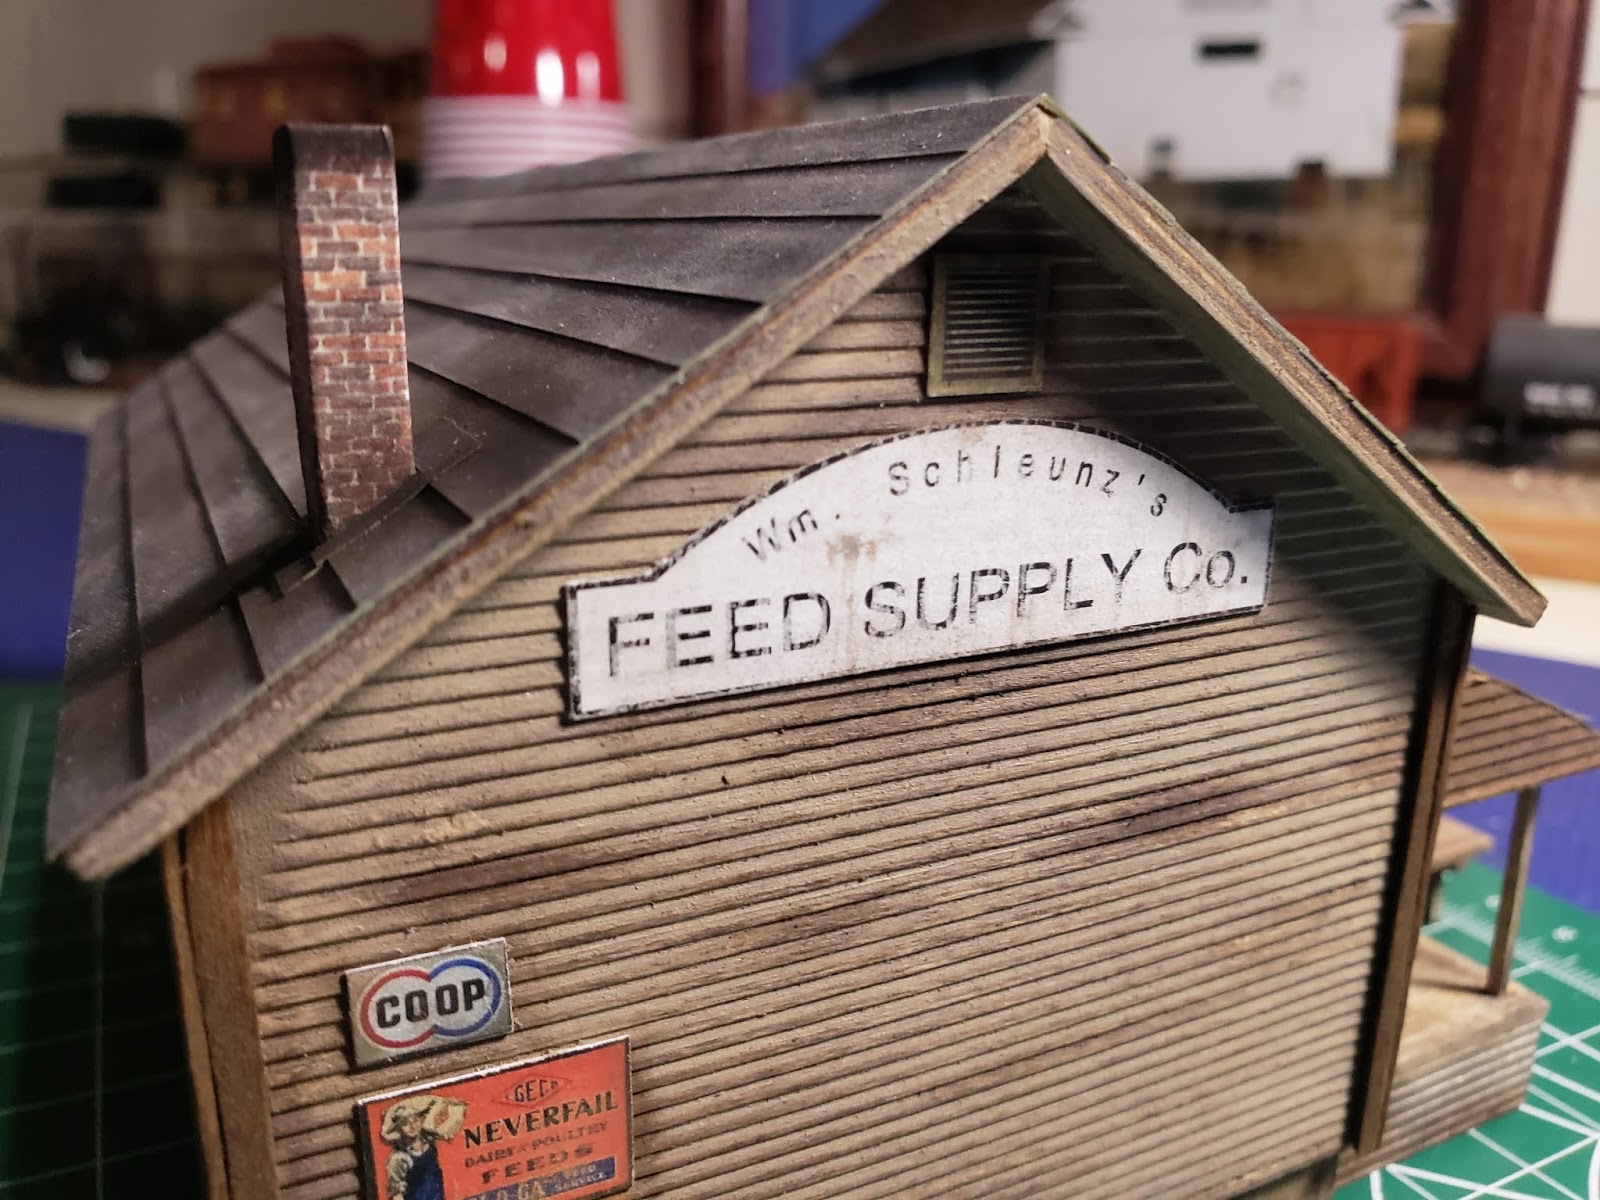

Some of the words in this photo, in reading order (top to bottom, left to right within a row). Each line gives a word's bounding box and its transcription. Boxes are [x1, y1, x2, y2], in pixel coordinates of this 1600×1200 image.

[741, 508, 841, 561] Wm.
[888, 445, 1168, 517] Schleunz's
[608, 592, 831, 678] FEED
[863, 548, 1143, 638] SUPPLY
[1164, 542, 1248, 594] Co.
[376, 977, 486, 1029] COOP
[463, 1091, 618, 1149] NEVERFAIL
[481, 1143, 594, 1185] FEEDS
